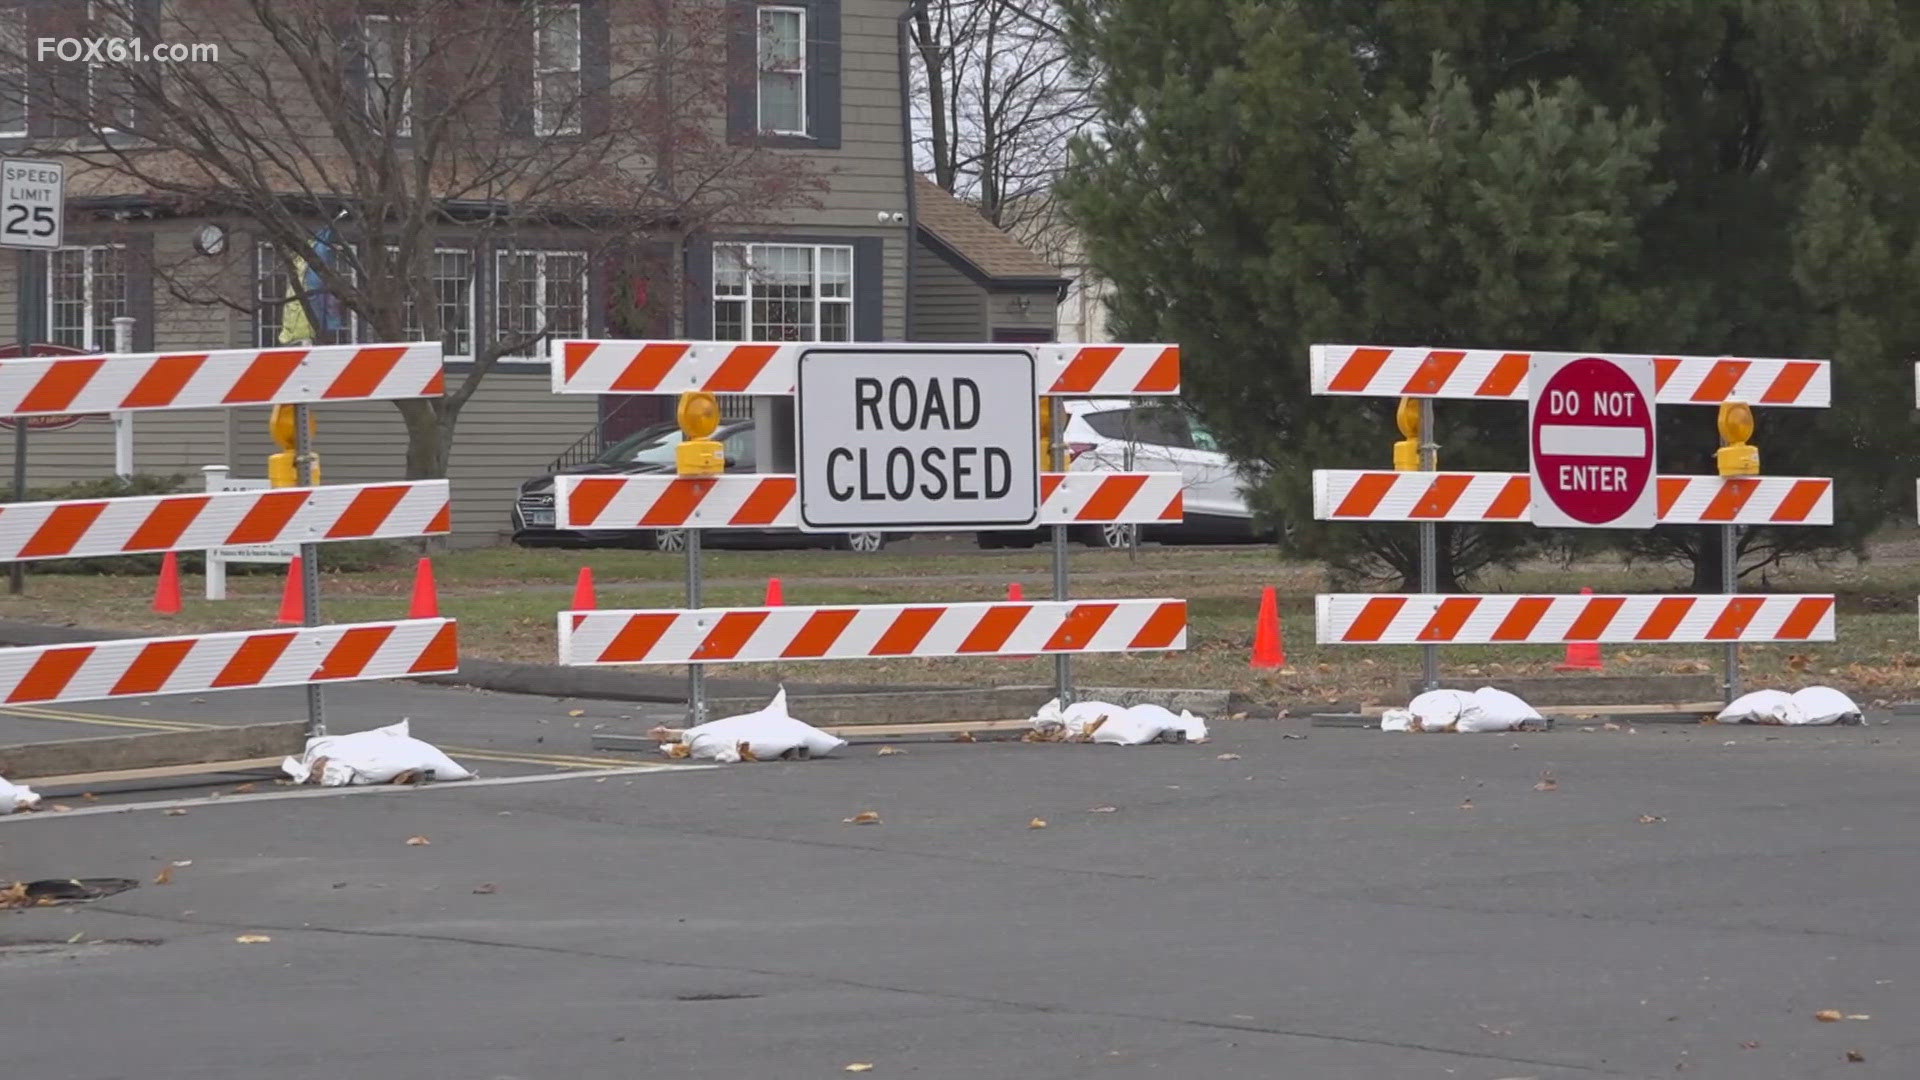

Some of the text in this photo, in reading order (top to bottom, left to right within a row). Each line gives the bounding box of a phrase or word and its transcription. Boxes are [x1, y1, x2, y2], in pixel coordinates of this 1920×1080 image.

[6, 168, 59, 184] SPEED
[10, 187, 52, 201] LIMIT
[5, 204, 56, 236] 25
[855, 376, 981, 431] ROAD
[1550, 390, 1635, 417] DO NOT
[826, 446, 1012, 502] CLOSED
[1559, 465, 1628, 492] ENTER
